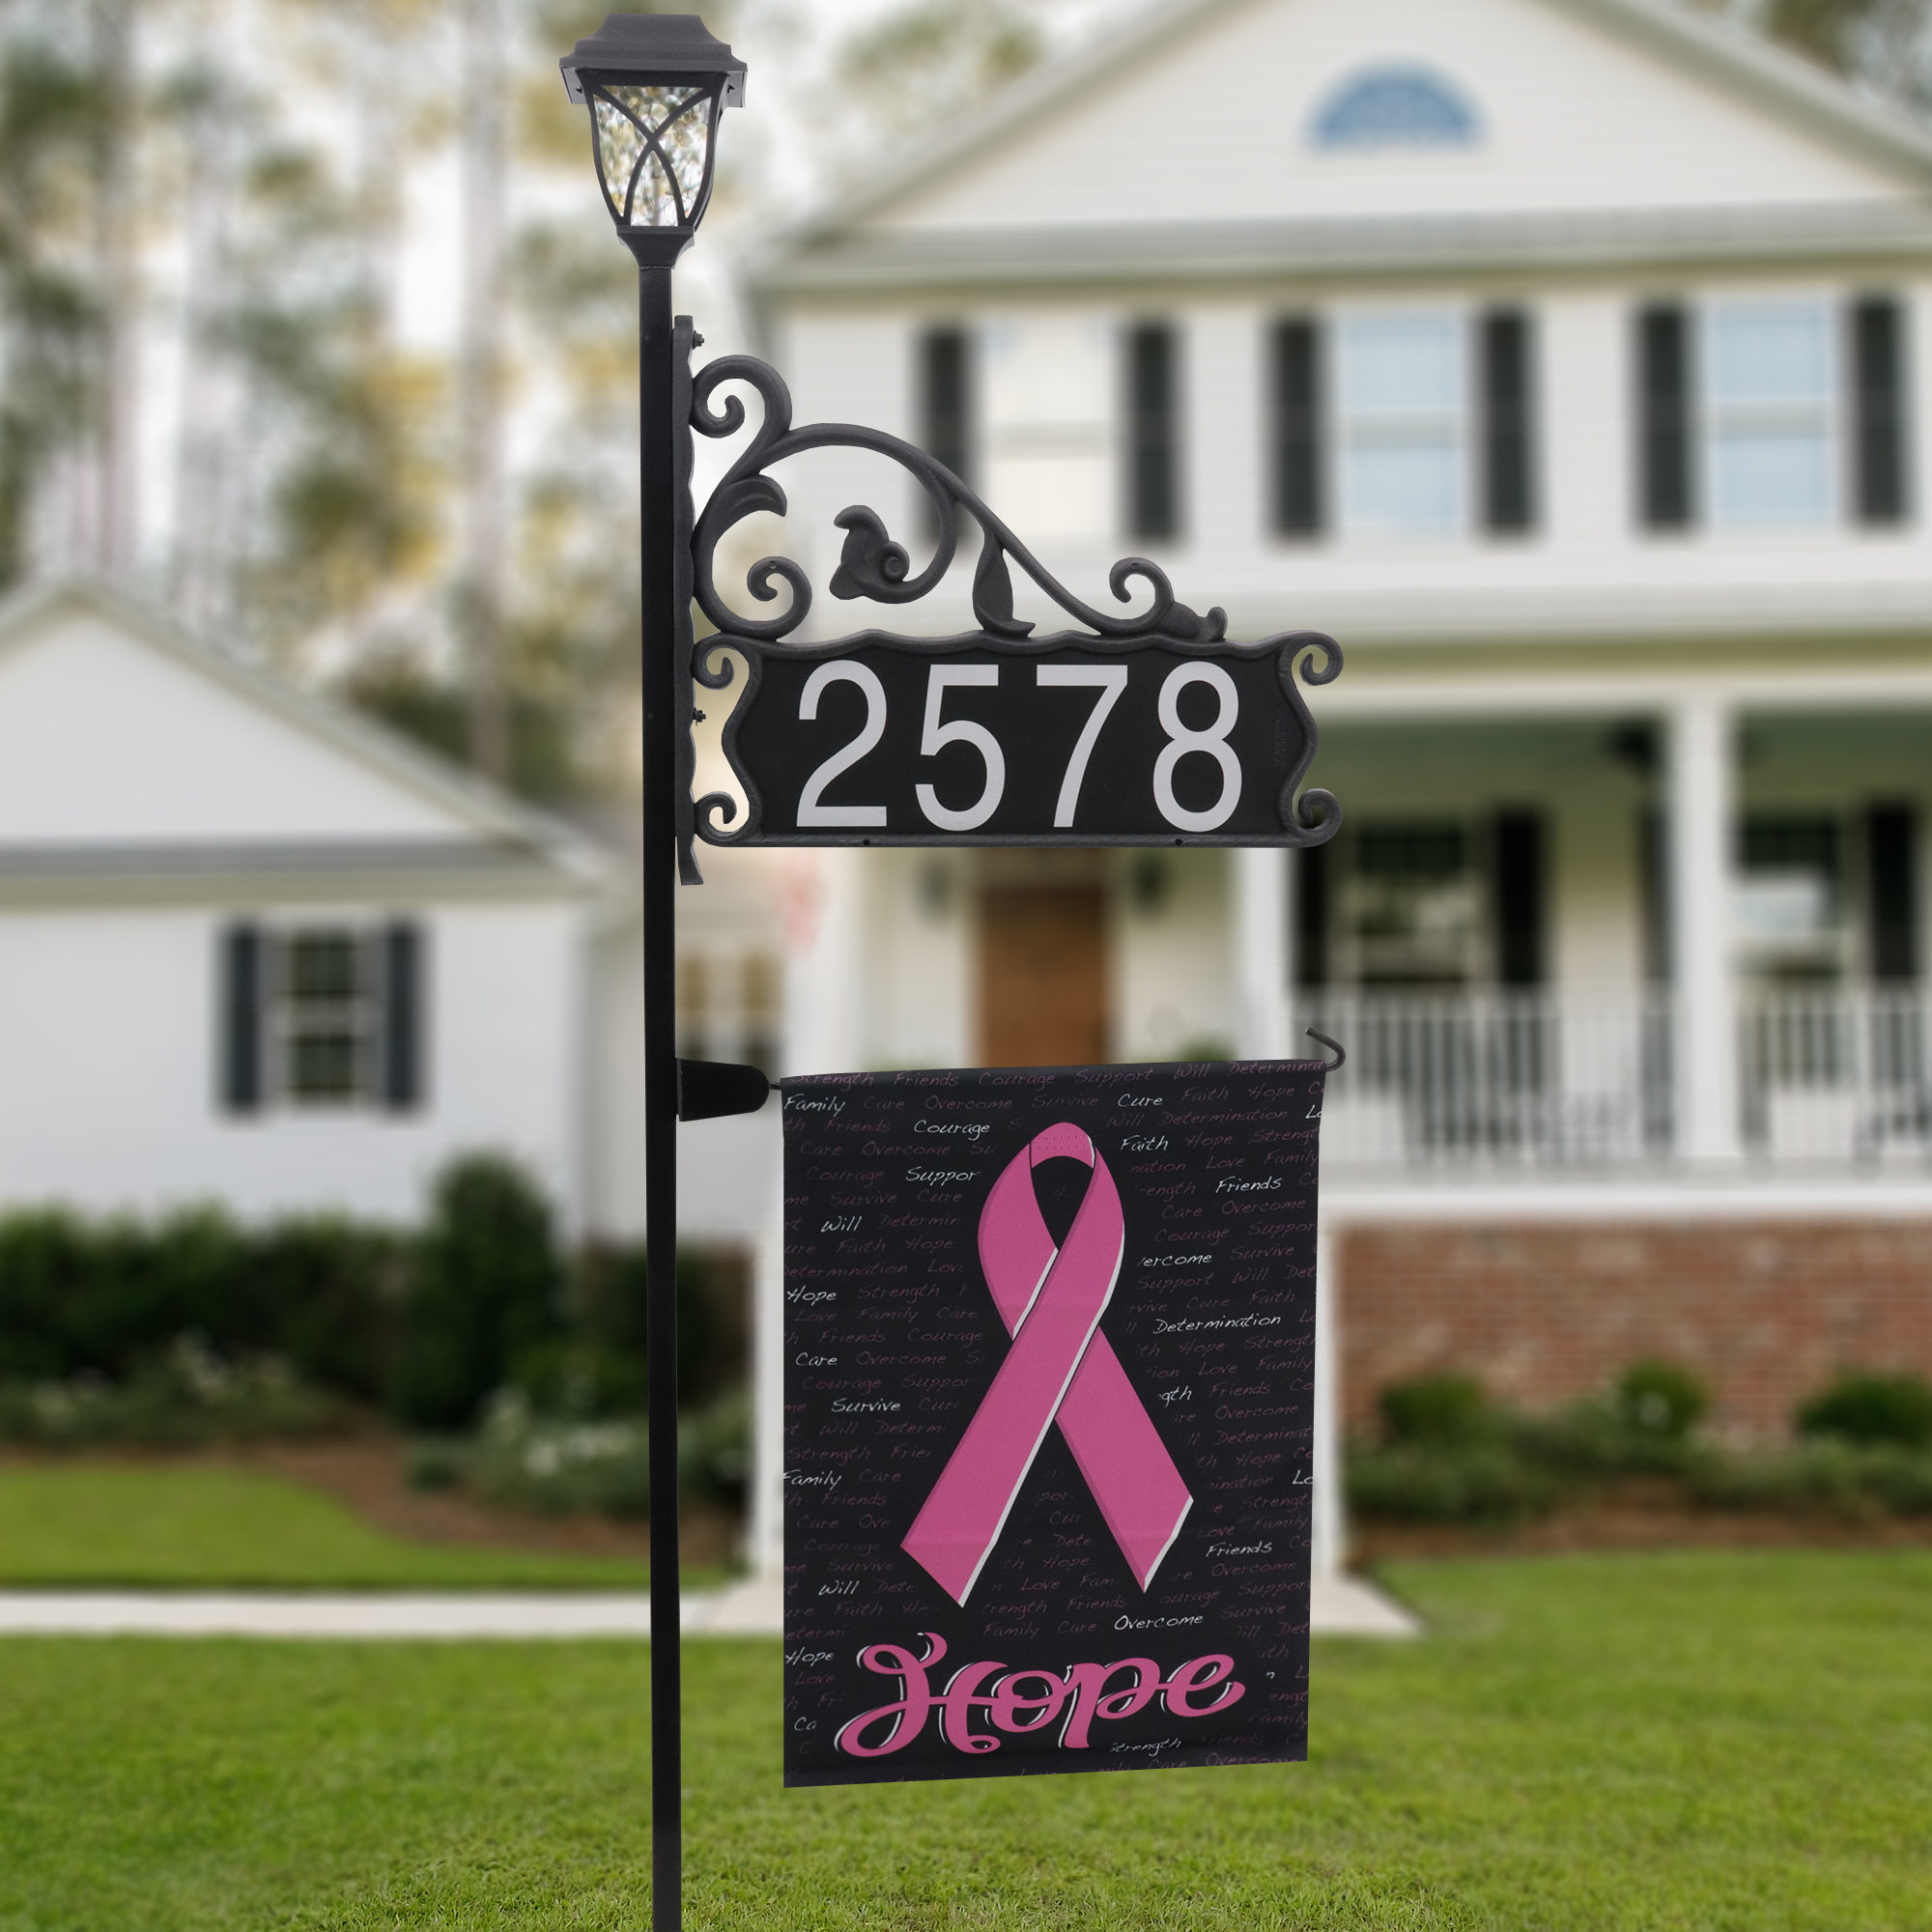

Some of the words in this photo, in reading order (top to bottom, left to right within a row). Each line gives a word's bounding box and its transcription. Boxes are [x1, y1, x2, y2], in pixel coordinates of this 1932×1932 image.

[796, 661, 1242, 832] 2578
[894, 1072, 959, 1088] Friends
[978, 1071, 1056, 1092] Courage
[1074, 1068, 1154, 1088] Support
[1173, 1064, 1210, 1080] Will
[783, 1094, 846, 1118] Family
[864, 1096, 906, 1111] Care
[924, 1094, 1013, 1110] Overcome
[1032, 1093, 1099, 1109] Survive
[1117, 1093, 1164, 1108] Cure
[1181, 1086, 1229, 1102] Faith
[1247, 1082, 1295, 1101] Hope
[825, 1119, 892, 1133] Friends
[913, 1119, 991, 1141] Courage
[1105, 1113, 1145, 1128] Will
[1159, 1109, 1288, 1127] Determination
[800, 1140, 842, 1156] Care
[862, 1141, 952, 1156] Overcome
[1120, 1134, 1169, 1151] Faith
[1187, 1131, 1234, 1151] Hope
[806, 1165, 885, 1188] Courage
[905, 1165, 980, 1187] Suppor
[1206, 1155, 1246, 1170] Love
[830, 1190, 897, 1207] Survive
[918, 1189, 963, 1203] Cure
[1214, 1175, 1284, 1194] Friends
[820, 1215, 863, 1234] Will
[1162, 1205, 1204, 1219] Care
[1221, 1200, 1306, 1215] Overcome
[837, 1236, 887, 1254] Faith
[904, 1234, 954, 1255] Hope
[1154, 1228, 1230, 1246] Courage
[783, 1261, 909, 1278] etermination
[1229, 1243, 1294, 1261] Survive
[785, 1284, 838, 1306] Hope
[858, 1282, 940, 1305] Strength
[1136, 1274, 1214, 1294] Support
[1232, 1266, 1269, 1284] Will
[795, 1309, 838, 1322] Love
[858, 1305, 919, 1323] Family
[937, 1306, 978, 1320] Care
[1186, 1296, 1231, 1310] Cure
[1248, 1289, 1295, 1305] Faith
[819, 1328, 887, 1344] Friends
[907, 1327, 983, 1349] Courage
[1152, 1313, 1282, 1334] Determination
[795, 1352, 839, 1367] Care
[856, 1350, 948, 1366] Overcome
[1179, 1339, 1226, 1357] Hope
[801, 1376, 882, 1396] Courage
[1198, 1361, 1237, 1377] Love
[1256, 1355, 1314, 1372] Family
[831, 1397, 902, 1413] Survive
[1208, 1381, 1272, 1398] Friends
[819, 1420, 860, 1435] Will
[1214, 1404, 1300, 1420] Overcome
[782, 1468, 842, 1491] Family
[859, 1468, 902, 1483] Care
[1236, 1450, 1283, 1468] Hope
[785, 1445, 872, 1467] Strength
[821, 1490, 888, 1507] Friends
[796, 1515, 840, 1529] Care
[1253, 1514, 1309, 1531] Family
[827, 1558, 895, 1573] Survive
[1043, 1553, 1091, 1573] Hope
[1205, 1540, 1274, 1558] Friends
[817, 1579, 860, 1597] Will
[1020, 1577, 1062, 1592] Love
[1210, 1561, 1298, 1577] Overcome
[833, 1600, 883, 1616] Faith
[1065, 1594, 1128, 1611] Friends
[982, 1622, 1040, 1640] Family
[1057, 1619, 1098, 1634] Care
[1113, 1613, 1204, 1631] Overcome
[1220, 1602, 1288, 1620] Survive
[784, 1646, 836, 1668] Hope
[794, 1670, 837, 1686] Love
[836, 1632, 1246, 1758] Hope
